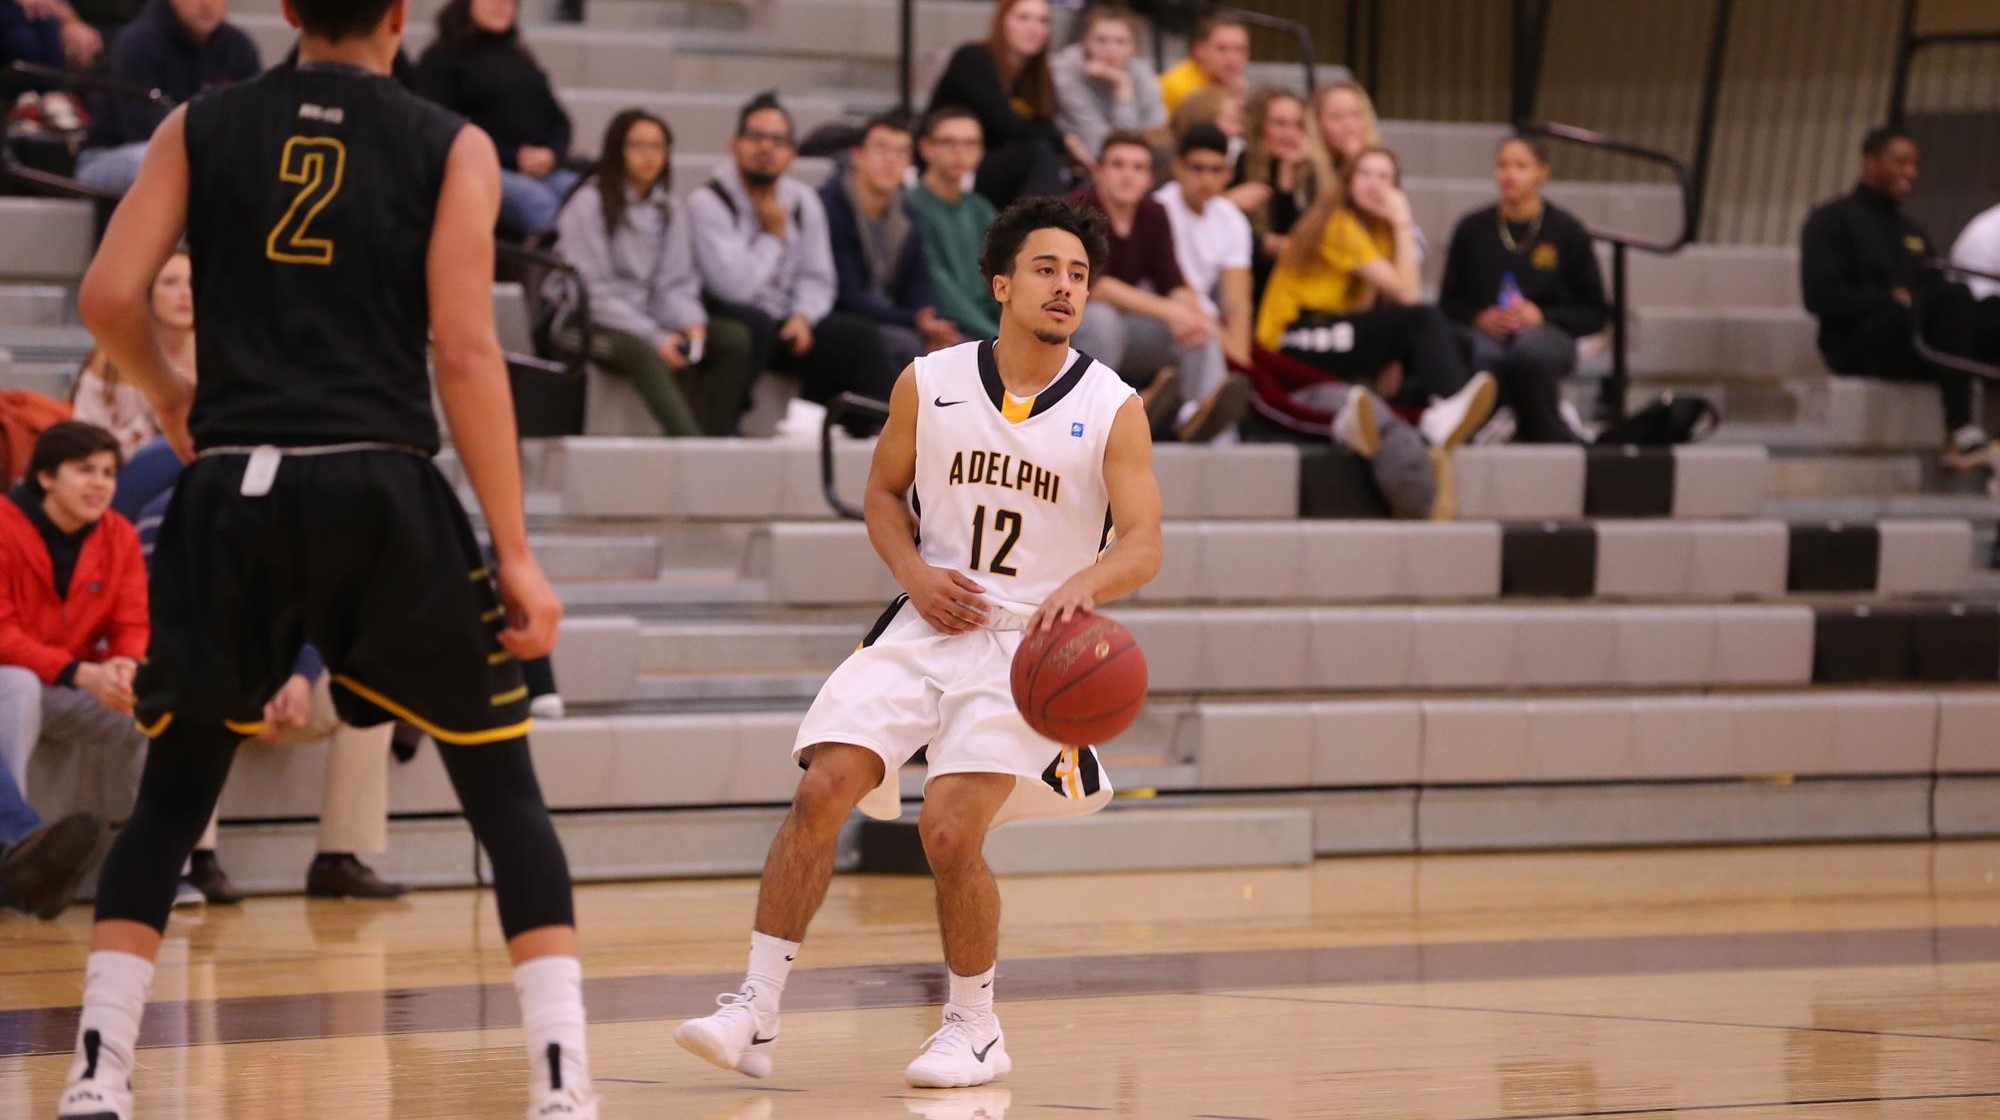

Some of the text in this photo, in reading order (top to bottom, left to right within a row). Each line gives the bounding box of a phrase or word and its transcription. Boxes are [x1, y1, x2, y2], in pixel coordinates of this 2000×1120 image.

[265, 135, 346, 266] 2
[949, 450, 1061, 504] ADELPHI
[969, 504, 1023, 577] 12
